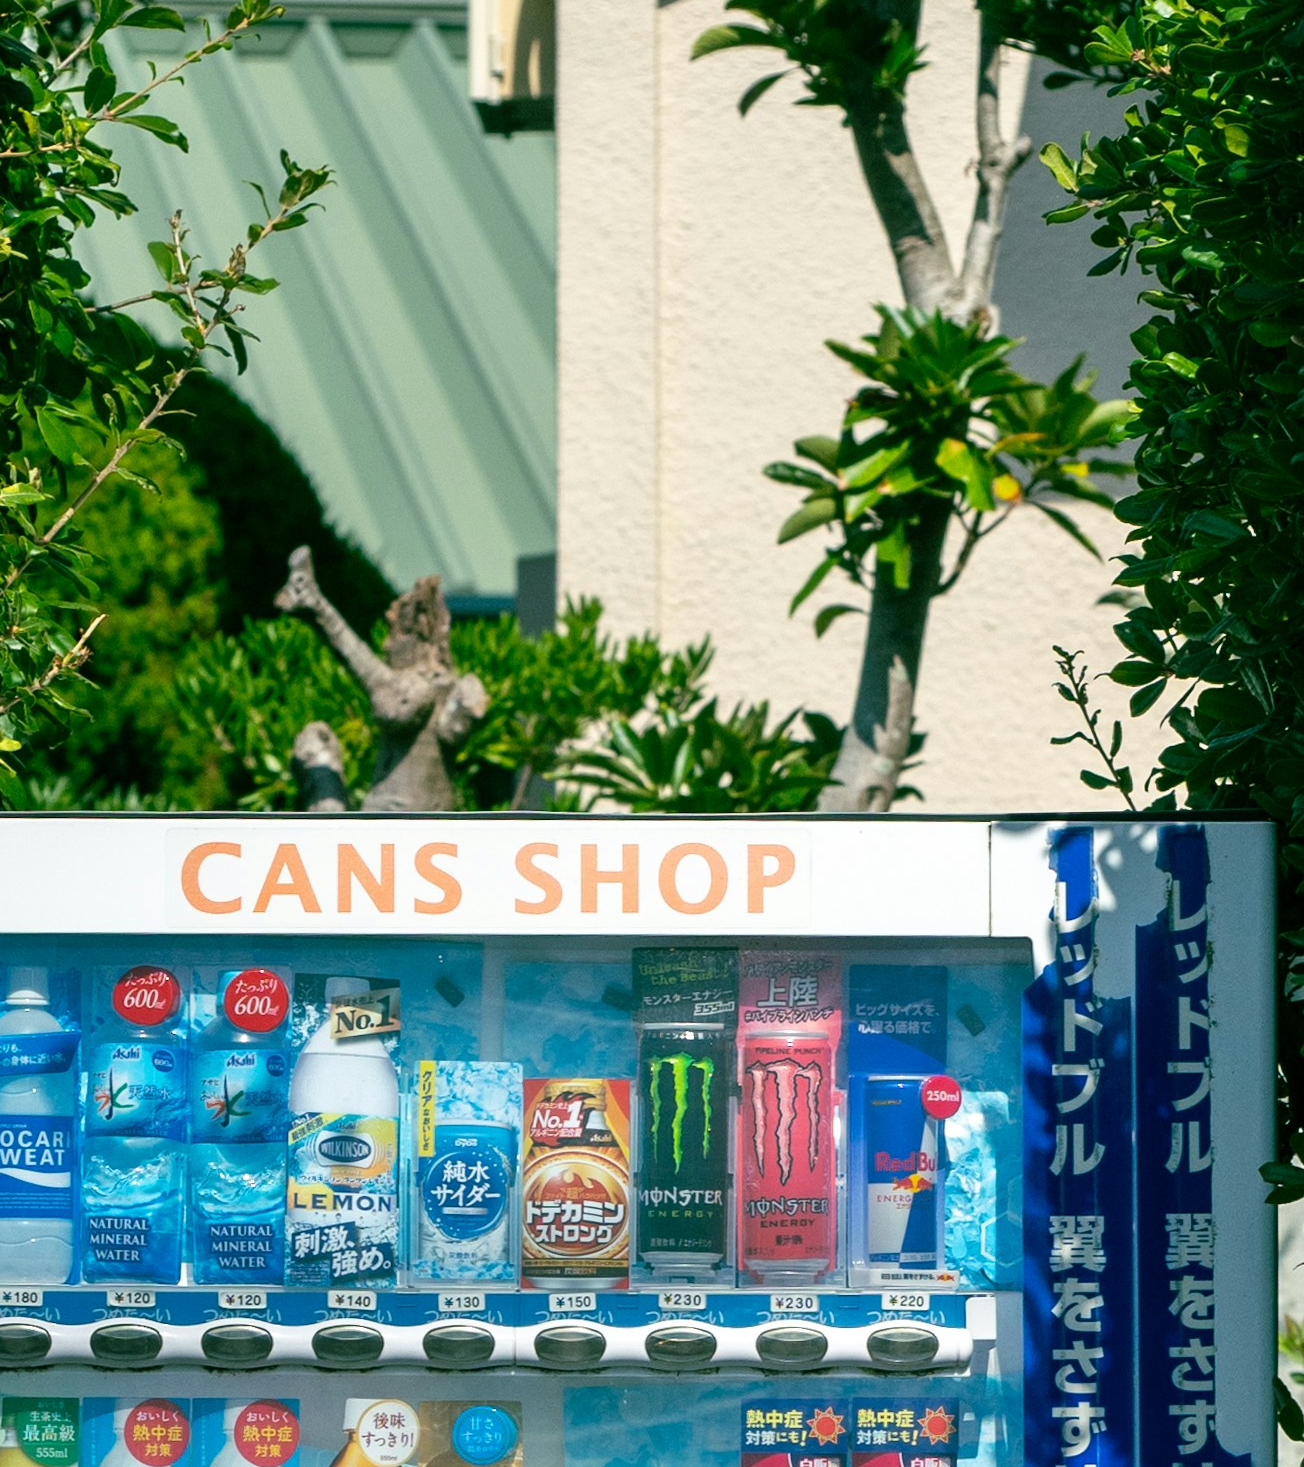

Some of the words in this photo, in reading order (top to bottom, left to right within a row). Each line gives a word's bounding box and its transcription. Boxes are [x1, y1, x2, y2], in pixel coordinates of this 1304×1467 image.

[180, 841, 463, 915] CANS
[513, 841, 796, 915] SHOP
[642, 988, 734, 1006] モンスターエナジー
[756, 976, 818, 1008] 上陸
[334, 994, 395, 1034] No.1
[1049, 880, 1106, 1176] レッドブル
[1165, 879, 1217, 1174] レッドブル
[320, 1140, 371, 1159] WILKINSON
[874, 1151, 916, 1172] Red
[442, 1160, 491, 1183] 純水
[293, 1192, 392, 1216] LEMON
[430, 1184, 501, 1207] サイダー
[525, 1199, 625, 1225] ドデカミン
[647, 1210, 714, 1218] ENERGY
[89, 1218, 150, 1232] NATURAL
[210, 1225, 274, 1238] NATURAL
[759, 1219, 816, 1228] ENERGY
[89, 1233, 148, 1246] MINERAL
[534, 1224, 613, 1243] ストロング
[211, 1240, 273, 1253] MINERAL
[294, 1227, 356, 1259] 刺激、
[95, 1249, 141, 1262] WATER
[218, 1256, 266, 1268] WATER
[331, 1248, 392, 1279] 強め。
[115, 1292, 151, 1304] ¥120
[335, 1294, 372, 1308] ¥140
[555, 1295, 592, 1308] ¥150
[775, 1295, 815, 1310] ¥230
[372, 1411, 407, 1429] 後味
[745, 1409, 803, 1429] 熱中症
[856, 1409, 914, 1429] 熱中症
[22, 1423, 76, 1442] 最高級
[132, 1425, 184, 1442] 熱中症
[242, 1425, 294, 1443] 熱中症
[361, 1430, 415, 1448] すっきり!
[745, 1430, 808, 1446] 対策にも!
[856, 1430, 919, 1446] 対策にも!
[35, 1446, 69, 1459] 555ml
[145, 1443, 173, 1458] 対策
[255, 1444, 282, 1459] 対策
